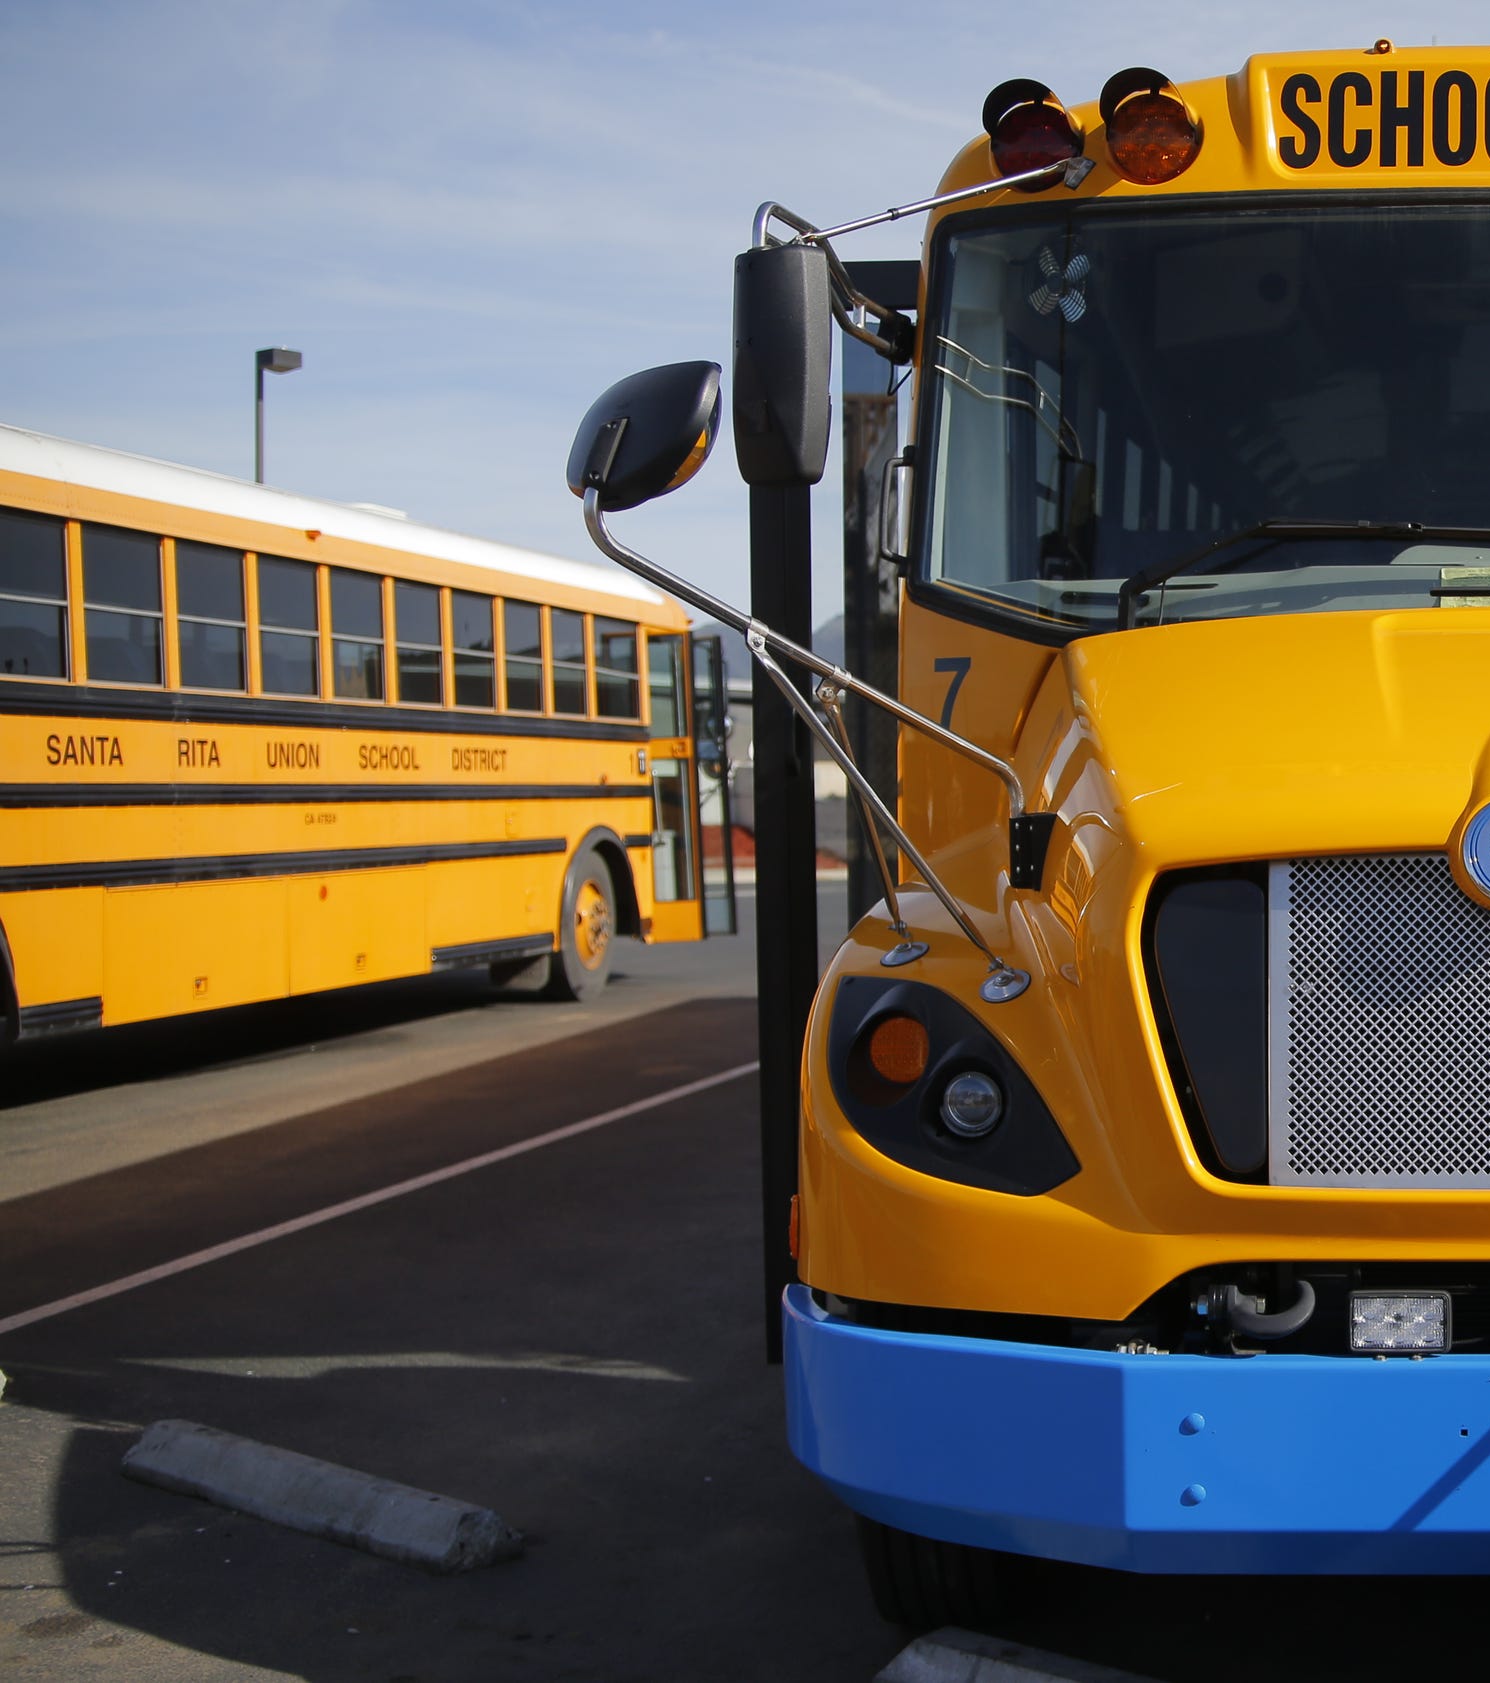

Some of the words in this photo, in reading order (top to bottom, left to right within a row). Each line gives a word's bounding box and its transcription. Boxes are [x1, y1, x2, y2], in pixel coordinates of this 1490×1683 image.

[934, 656, 971, 731] 7
[46, 734, 124, 767] SANTA
[178, 739, 221, 768] RITA
[266, 742, 320, 769] UNION
[358, 745, 420, 771] SCHOOL
[451, 749, 507, 772] DISTRICT
